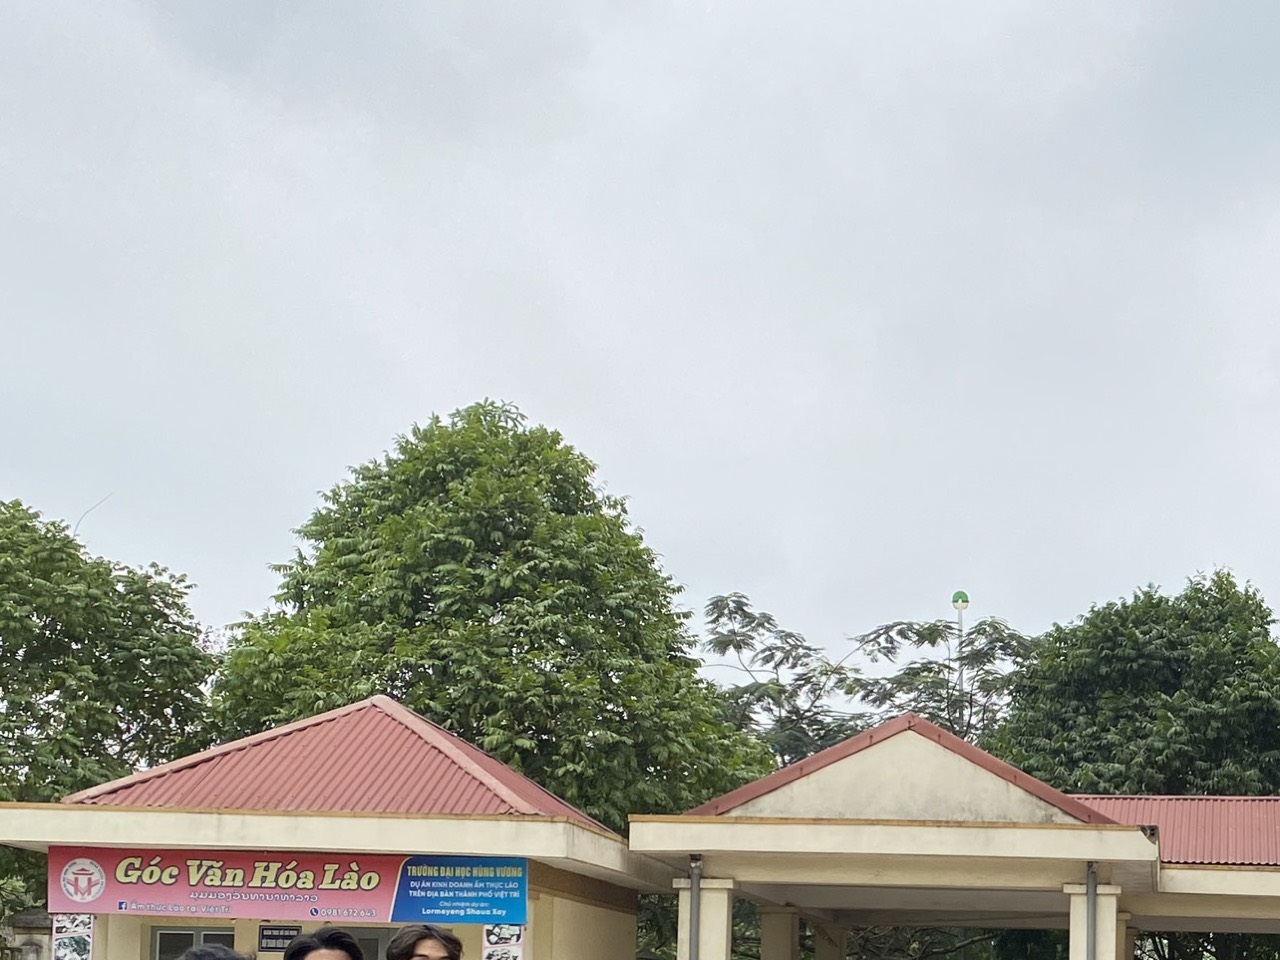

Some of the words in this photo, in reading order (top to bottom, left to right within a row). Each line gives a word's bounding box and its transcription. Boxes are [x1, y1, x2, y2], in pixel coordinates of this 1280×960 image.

[114, 856, 180, 885] Góc
[185, 859, 245, 887] Văn
[247, 860, 316, 889] Hóa
[317, 861, 381, 890] Lào
[407, 863, 439, 877] TRƯỜNG
[440, 866, 454, 878] ĐẠI
[455, 866, 472, 879] HỌC
[472, 864, 495, 877] HÙNG
[496, 866, 522, 877] VƯƠNG
[421, 880, 431, 888] ÁN
[486, 881, 504, 890] THỰC
[504, 880, 519, 889] LÀO
[409, 889, 426, 897] TRÊN
[426, 890, 439, 899] ĐỊA
[440, 889, 454, 897] BÀN
[455, 889, 477, 898] THÀNH
[478, 889, 493, 898] PHỐ
[494, 890, 509, 899] VIỆT
[320, 908, 341, 916] 0981
[343, 908, 358, 916] 672
[360, 909, 376, 917] 643
